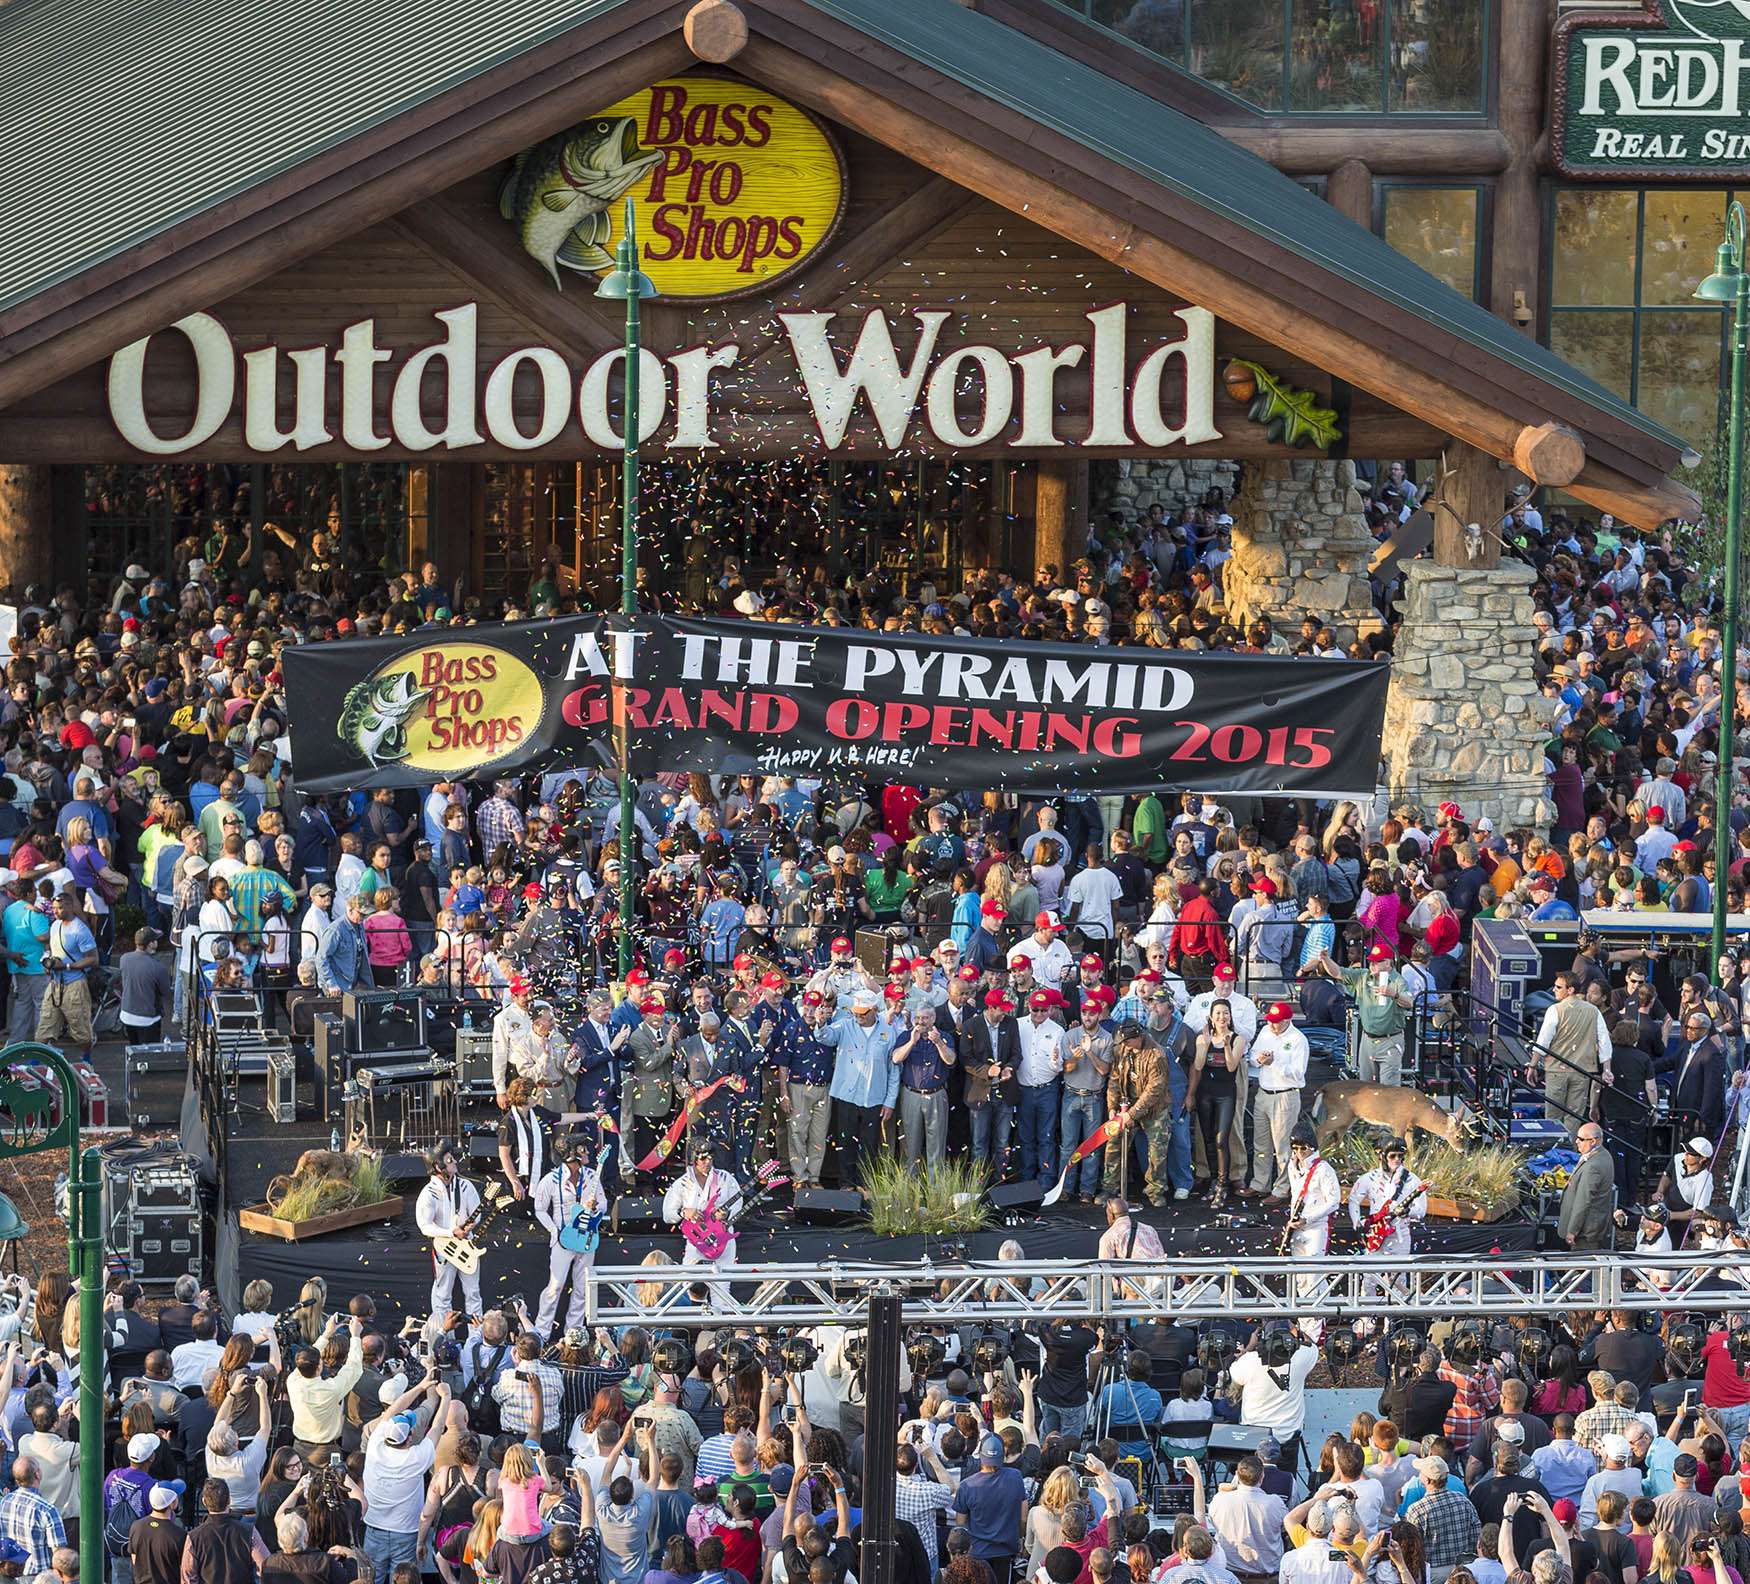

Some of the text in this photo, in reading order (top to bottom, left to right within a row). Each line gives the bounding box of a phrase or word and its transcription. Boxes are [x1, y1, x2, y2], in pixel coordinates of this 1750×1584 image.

[640, 85, 775, 148] Bass
[1589, 127, 1688, 159] REAL
[644, 145, 744, 206] Pro
[643, 203, 805, 273] Shops
[105, 300, 1224, 455] Outdoor World
[419, 650, 498, 688] Bass
[563, 631, 1196, 712] AT THE PYRAMID
[424, 684, 485, 720] Pro
[561, 684, 1337, 769] GRAND OPENING 2015
[427, 714, 524, 755] Shops
[757, 746, 823, 770] HAPPY
[865, 745, 920, 769] HERE!
